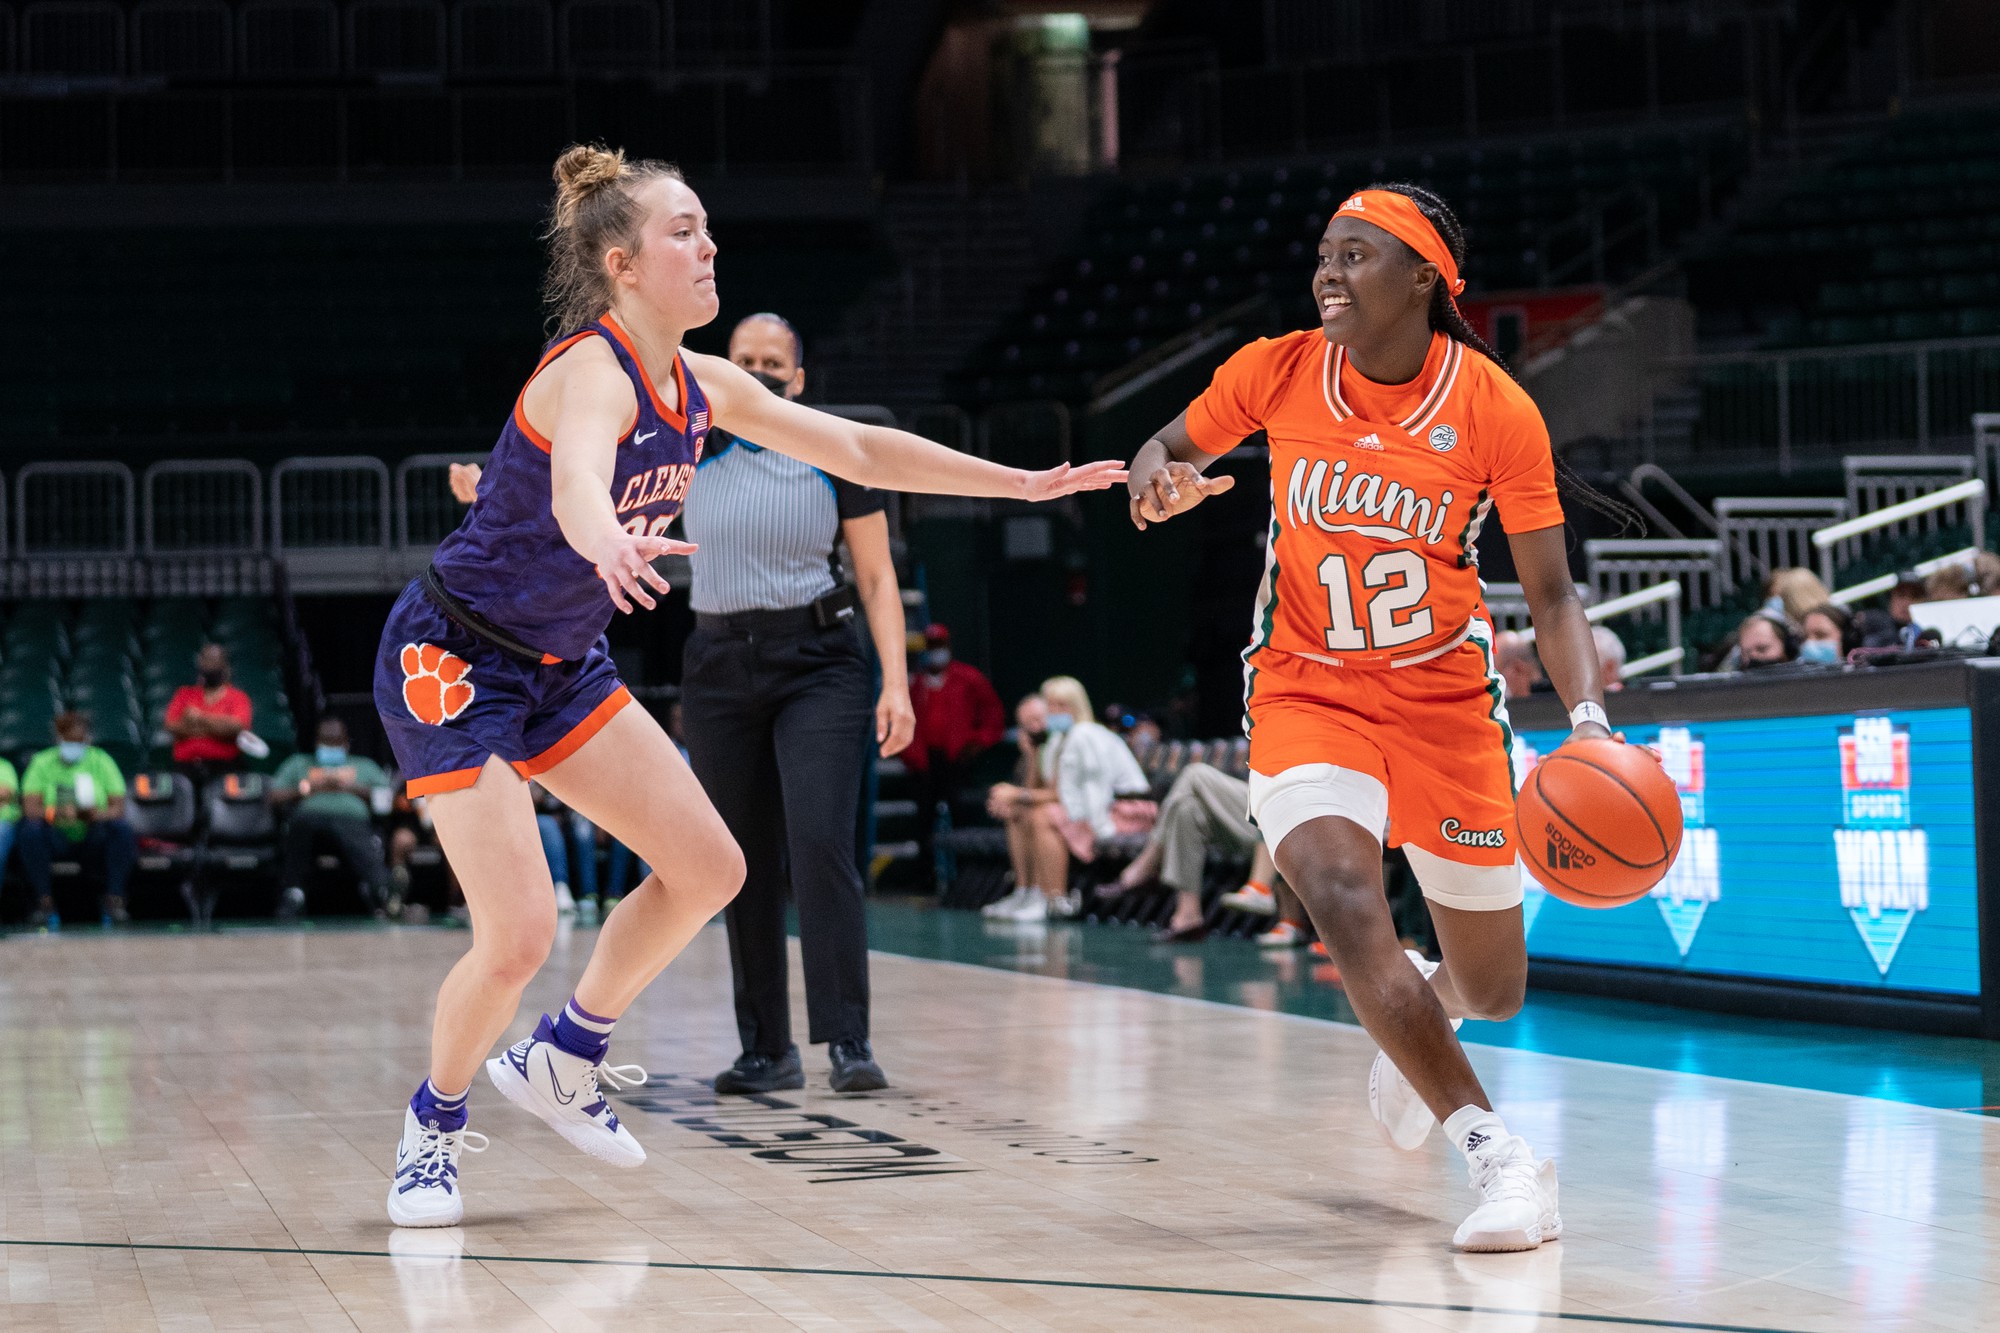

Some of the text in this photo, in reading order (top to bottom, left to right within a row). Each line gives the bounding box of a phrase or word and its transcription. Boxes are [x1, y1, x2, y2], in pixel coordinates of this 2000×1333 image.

[1353, 440, 1385, 451] adidas
[616, 463, 697, 514] CLEMSO
[1287, 457, 1454, 545] Miami
[1316, 548, 1435, 650] 12
[1440, 816, 1507, 848] Canes
[1544, 821, 1596, 867] adidas
